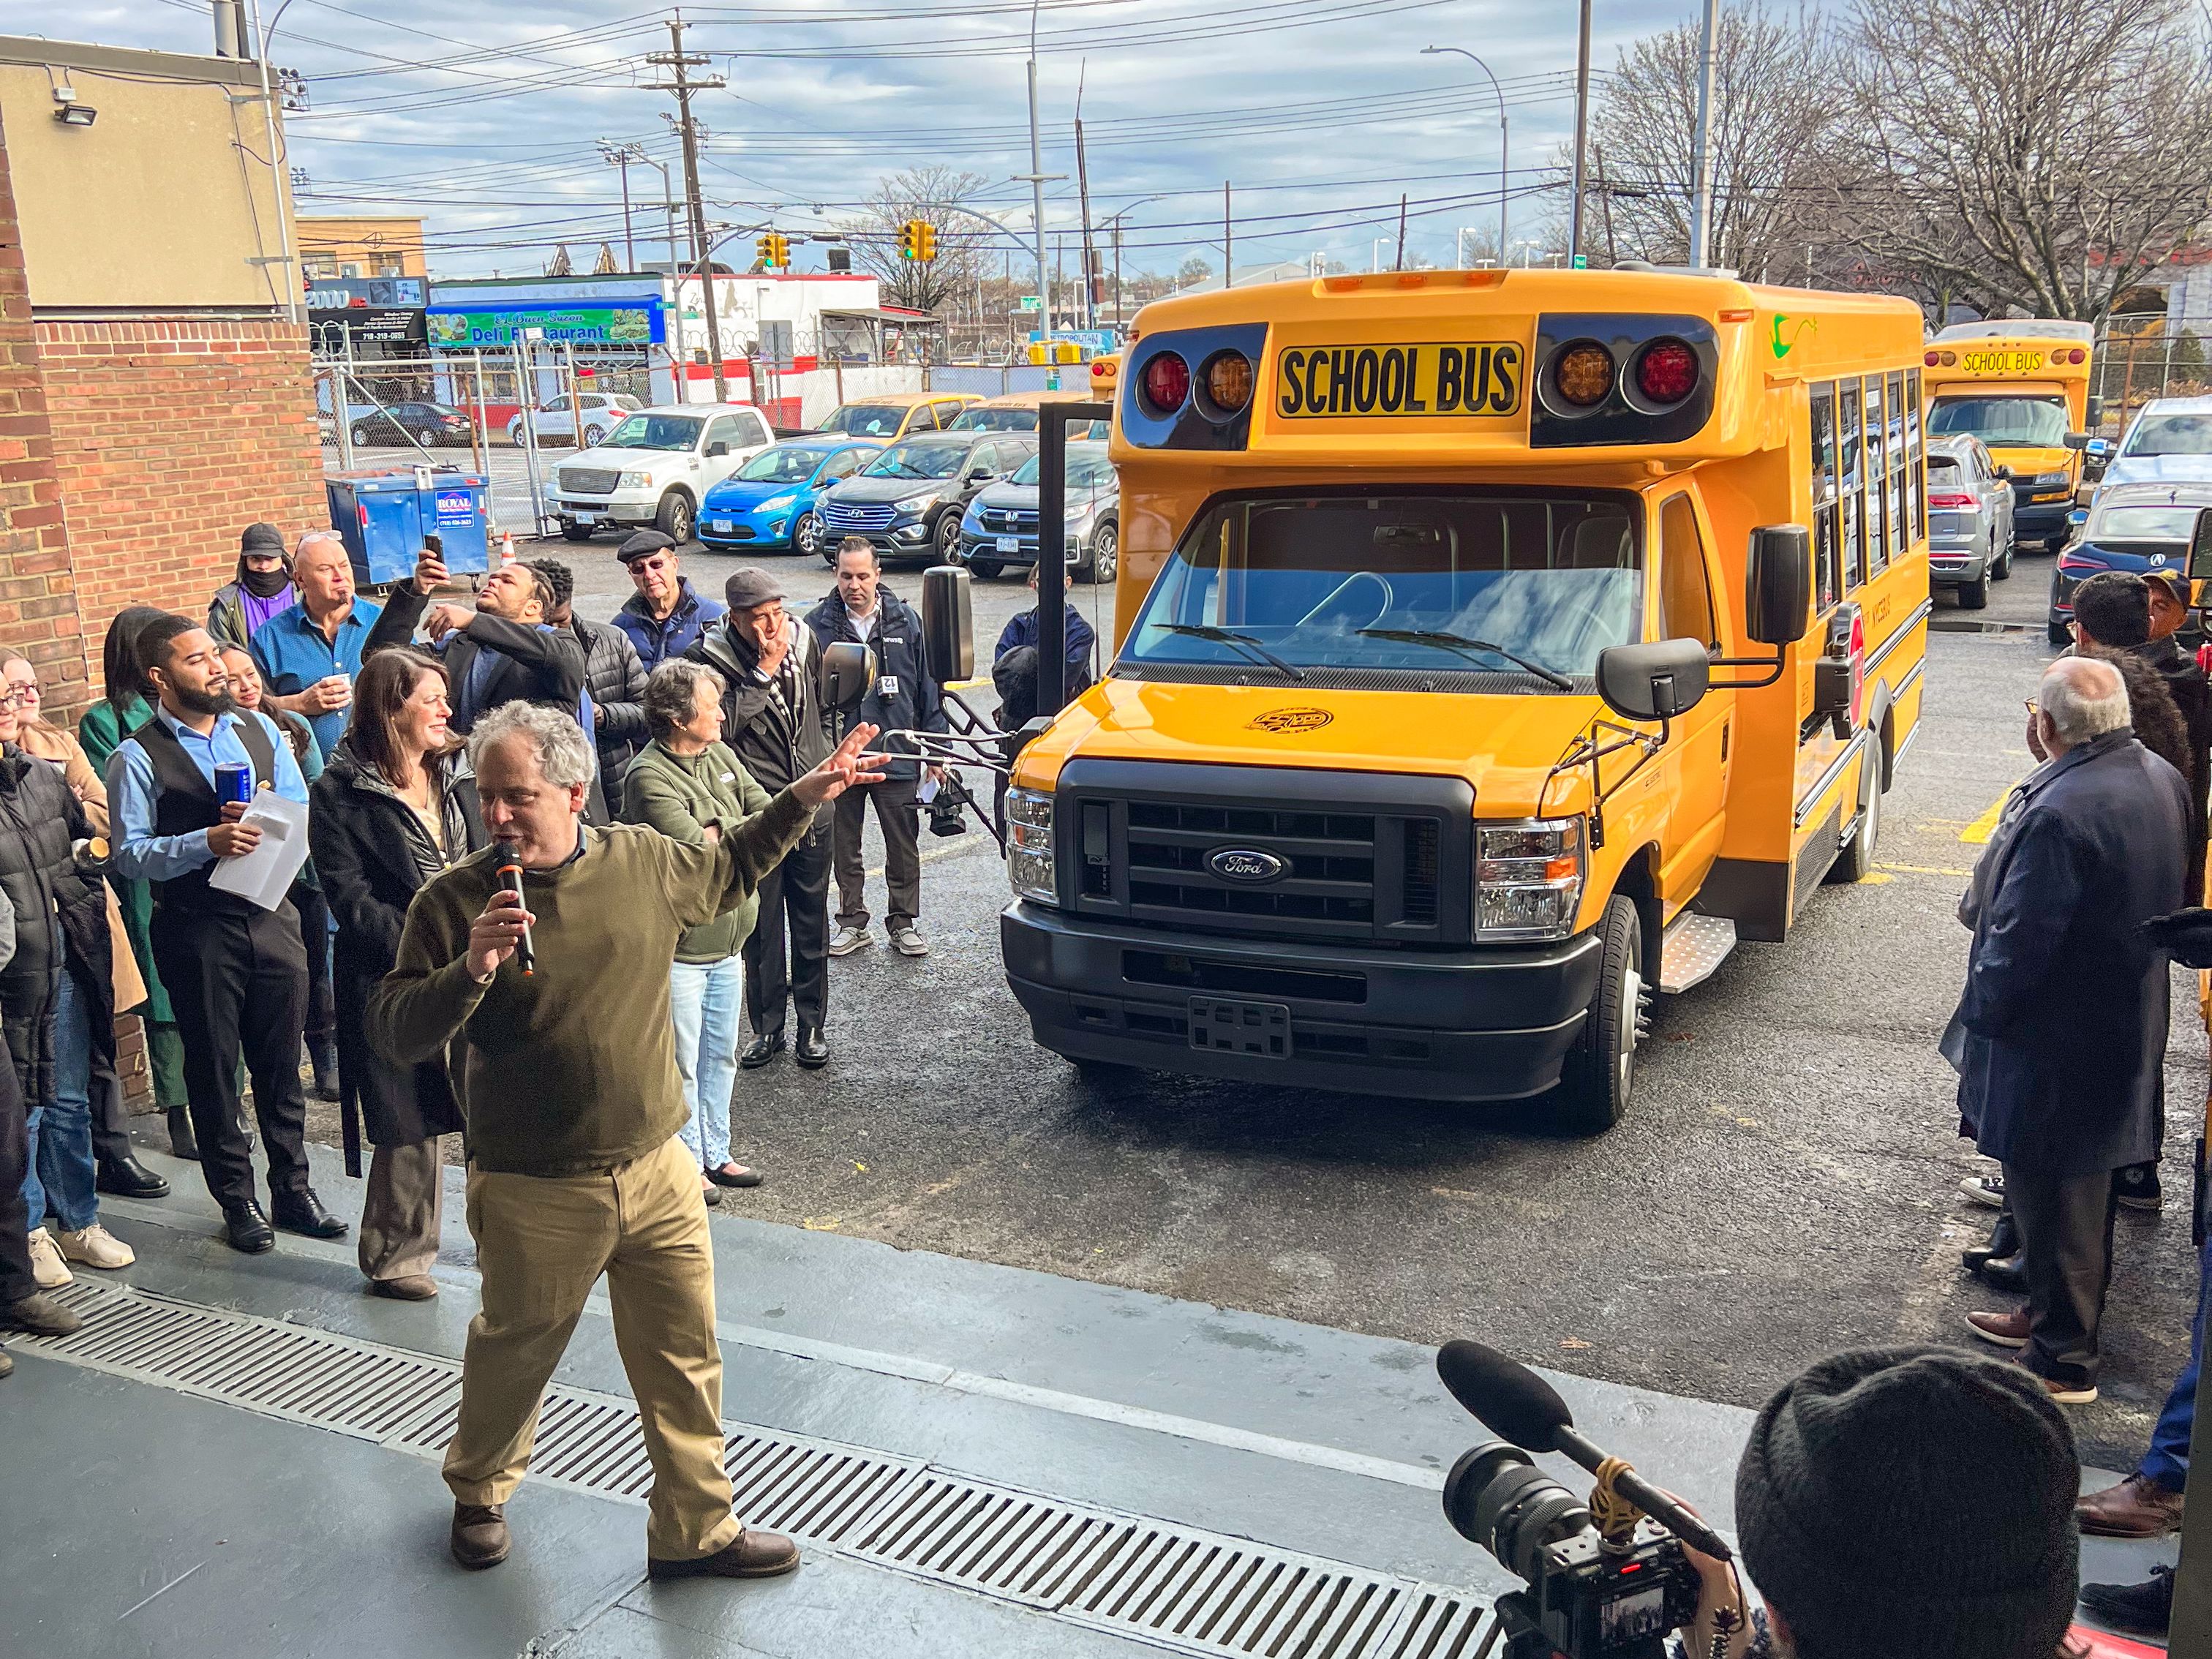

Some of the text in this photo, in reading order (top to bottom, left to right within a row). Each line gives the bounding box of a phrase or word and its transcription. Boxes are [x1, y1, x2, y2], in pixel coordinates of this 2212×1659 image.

[304, 290, 350, 309] 2000
[515, 311, 544, 324] Buen
[549, 310, 584, 323] Sazon
[472, 327, 503, 342] Deli
[511, 325, 603, 342] Rtaurant
[1963, 353, 2041, 371] SCHOOL BUS
[1282, 345, 1519, 415] SCHOOL BUS
[437, 498, 472, 508] ROYAL
[1224, 855, 1263, 874] Ford
